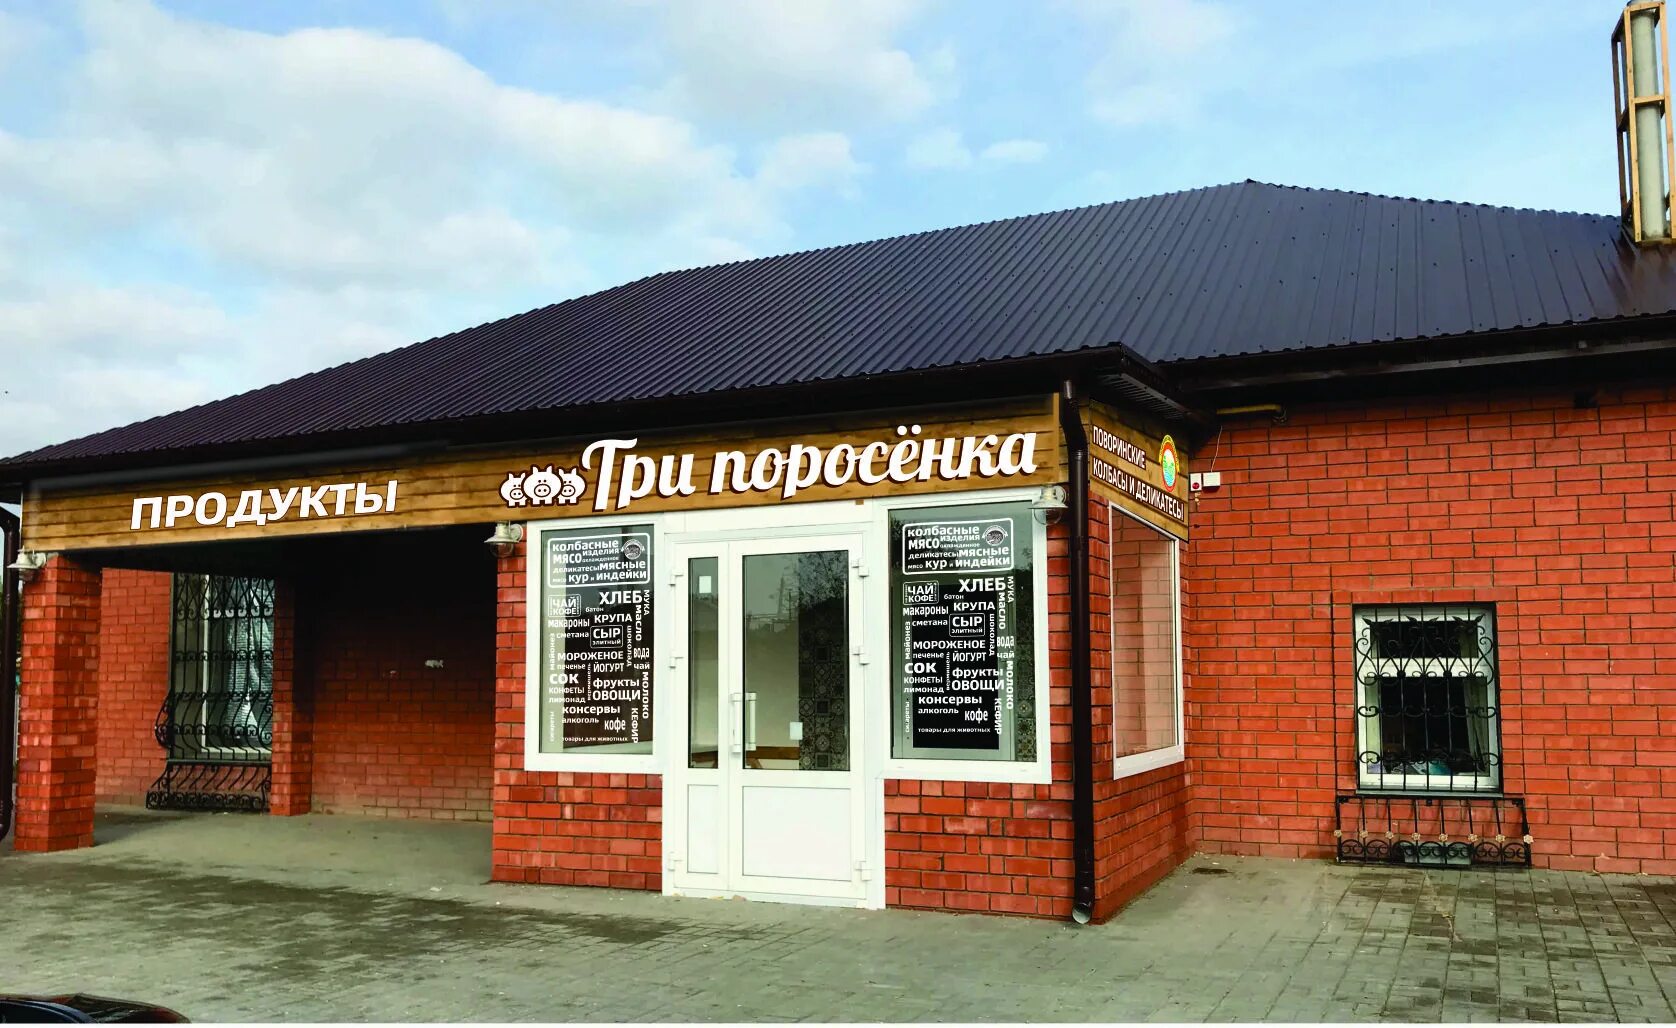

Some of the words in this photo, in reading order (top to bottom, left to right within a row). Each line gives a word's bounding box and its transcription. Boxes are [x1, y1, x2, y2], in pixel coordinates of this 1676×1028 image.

[1093, 425, 1146, 469] ПОВОРИНСКИЕ
[582, 438, 695, 511] Три
[710, 425, 1038, 499] поросёнка
[1093, 457, 1128, 492] КОЛБАСЫ
[1130, 477, 1135, 496] И
[1136, 483, 1184, 520] ДЕЛИКАТЕСЫ
[130, 480, 398, 530] ПРОДУКТЫ
[908, 526, 979, 537] колбасные
[940, 534, 980, 542] изделия
[552, 540, 619, 552] колбасные
[909, 538, 940, 550] мясо
[582, 548, 619, 556] изделия
[908, 551, 959, 560] деликатесы
[959, 546, 1009, 557] мясные
[553, 553, 582, 564] мясо
[925, 559, 947, 570] кур
[955, 556, 1010, 568] индейки
[600, 560, 646, 570] мясные
[568, 573, 589, 584] кур
[596, 570, 646, 581] индейки
[908, 583, 934, 594] ЧАЙ
[959, 577, 1006, 592] ХЛЕБ
[553, 596, 576, 607] ЧАЙ
[599, 590, 642, 605] ХЛЕБ
[908, 594, 934, 602] КОФЕ
[903, 606, 948, 617] макароны
[953, 602, 995, 611] КРУПА
[594, 613, 632, 623] КРУПА
[952, 616, 982, 627] СЫР
[548, 619, 590, 629] макароны
[593, 628, 620, 638] СЫР
[913, 640, 986, 650] МОРОЖЕНОЕ
[997, 636, 1014, 648] вода
[557, 651, 624, 661] МОРОЖЕНОЕ
[634, 648, 650, 660] вода
[952, 651, 986, 662] ЙОГУРТ
[997, 651, 1015, 659] чай
[594, 662, 624, 672] ЙОГУРТ
[634, 662, 650, 670] чай
[952, 667, 1003, 678] фрукты
[592, 678, 639, 689] фрукты
[952, 680, 1004, 692] ОВОЩИ
[549, 686, 584, 694] КОНФЕТЫ
[592, 690, 641, 701] ОВОЩИ
[919, 696, 982, 706] консервы
[562, 706, 620, 715] консервы
[965, 708, 988, 724] кофе
[604, 717, 625, 733] кофе
